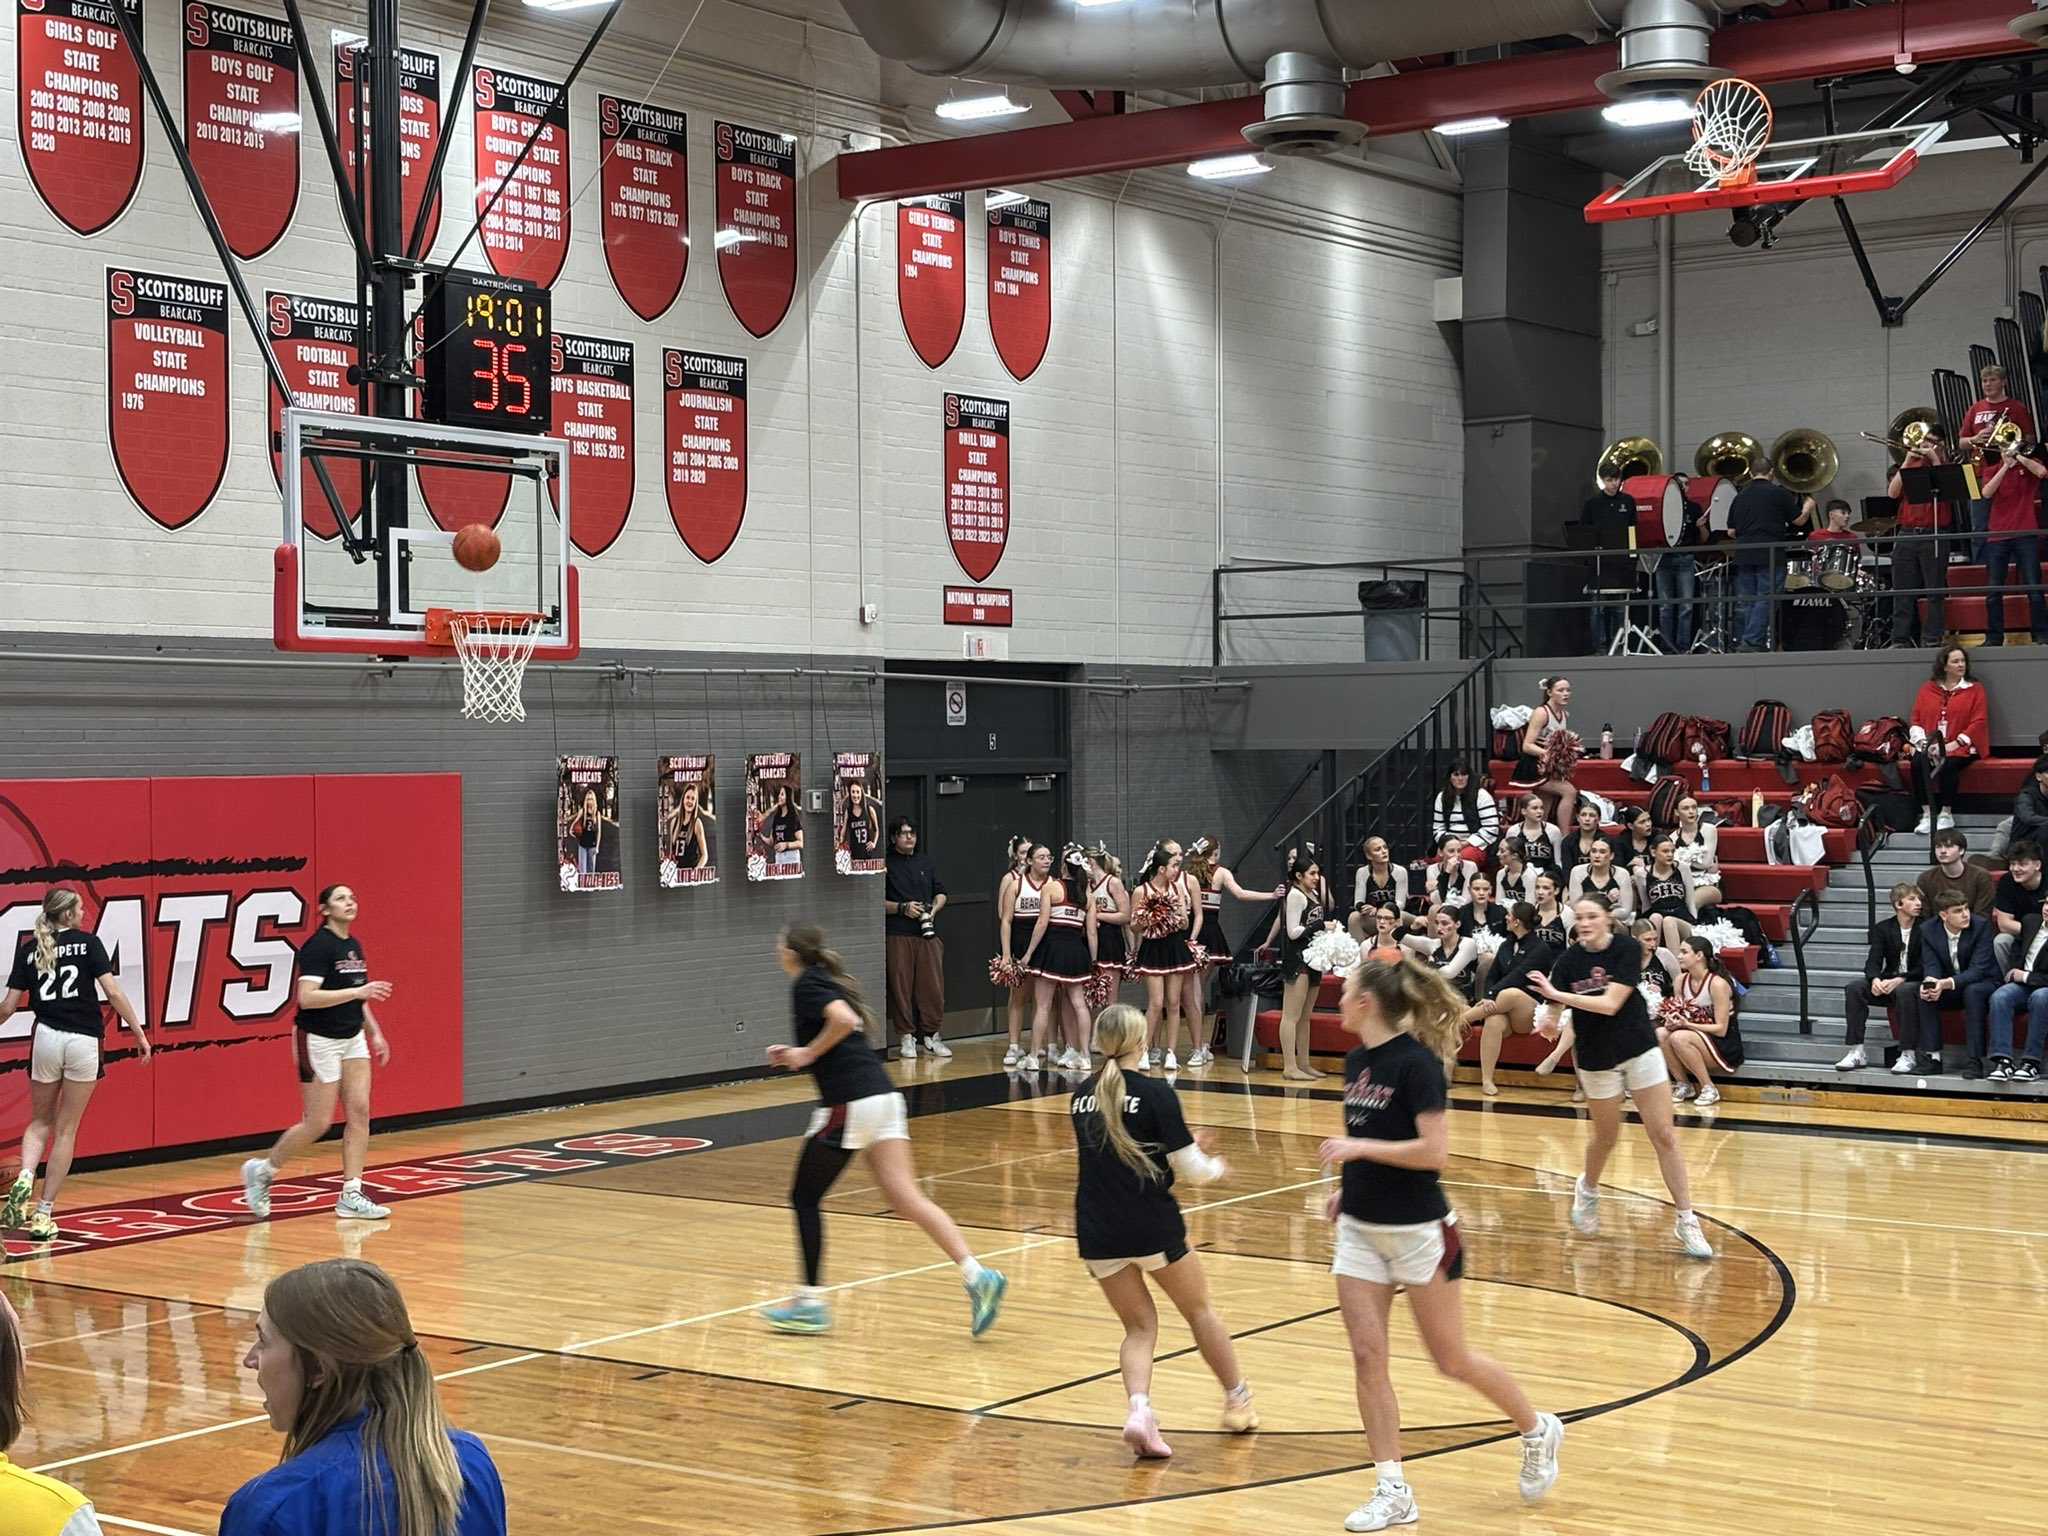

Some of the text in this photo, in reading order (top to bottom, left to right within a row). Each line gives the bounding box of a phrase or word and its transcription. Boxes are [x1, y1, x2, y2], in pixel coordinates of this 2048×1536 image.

[71, 3, 117, 25] BEARCATS
[45, 19, 118, 50] GIRLS GOLF
[186, 3, 209, 47] S
[211, 11, 294, 44] SCOTTSBLUFF
[233, 39, 274, 59] BEARCATS
[64, 49, 100, 72] STATE
[211, 55, 274, 83] BOYS GOLF
[45, 71, 119, 100] CHAMPIONS
[226, 83, 259, 104] STATE
[475, 68, 495, 109] S
[31, 90, 131, 123] 2003 2006 2008 2009
[491, 113, 518, 135] BOYS
[602, 98, 619, 136] S
[621, 104, 683, 132] SCOTTSBLUFF
[31, 112, 131, 145] 2010 2013 2014 2019
[197, 122, 265, 150] 2010 2013 2015
[400, 119, 430, 139] STATE
[637, 128, 668, 145] BEARCATS
[32, 133, 55, 152] 2020
[717, 123, 733, 160] S
[734, 129, 793, 156] SCOTTSBLUFF
[532, 145, 560, 165] STATE
[616, 142, 673, 168] GIRLS TRACK
[749, 153, 778, 169] BEARCATS
[632, 167, 658, 185] STATE
[731, 166, 782, 191] BOYS TRACK
[620, 185, 671, 209] CHAMPIONS
[745, 190, 769, 208] STATE
[610, 201, 627, 218] 1976
[629, 204, 645, 221] 1977
[663, 211, 679, 228] 2007
[733, 207, 781, 230] CHAMPIONS
[908, 210, 955, 233] GIRLS TENNIS
[525, 221, 542, 237] 2010
[485, 231, 523, 252] 2013 2014
[922, 232, 942, 249] STATE
[999, 229, 1040, 250] BOYS TENNIS
[912, 249, 952, 269] CHAMPIONS
[1010, 250, 1029, 266] STATE
[472, 277, 524, 293] DAKTRONICS
[1001, 266, 1039, 285] CHAMPIONS
[111, 271, 134, 315] S
[137, 277, 223, 307] SCOTTSBLUFF
[160, 305, 202, 322] BEARCATS
[270, 295, 291, 337] S
[467, 294, 543, 337] 19:01
[134, 322, 205, 348] VOLLEYBALL
[314, 326, 352, 343] BEARCATS
[153, 350, 187, 370] STATE
[297, 345, 349, 367] FOOTBALL
[565, 339, 630, 362] SCOTTSBLUFF
[582, 362, 615, 377] BEARCATS
[666, 350, 682, 387] S
[684, 355, 744, 377] SCOTTSBLUFF
[135, 373, 205, 397] CHAMPIONS
[308, 369, 339, 388] STATE
[472, 339, 531, 414] 35
[699, 377, 729, 391] BEARCATS
[551, 376, 631, 400] BOYS BASKETBALL
[121, 392, 144, 411] 1976
[292, 391, 356, 414] CHAMPIONS
[577, 401, 604, 418] STATE
[679, 393, 732, 412] JOURNALISM
[946, 395, 959, 427] S
[960, 399, 1007, 418] SCOTTSBLUFF
[564, 421, 617, 441] CHAMPIONS
[694, 415, 719, 431] STATE
[972, 418, 995, 430] BEARCATS
[682, 434, 731, 453] CHAMPIONS
[959, 431, 996, 448] DRILL TEAM
[608, 444, 625, 459] 2012
[673, 451, 688, 466] 2001
[690, 452, 706, 467] 2004
[707, 454, 722, 469] 2005
[968, 451, 987, 465] STATE
[673, 468, 706, 484] 2019 2020
[959, 468, 997, 485] CHAMPIONS
[947, 591, 1009, 607] NATIONAL CHAMPIONS
[669, 756, 706, 769] SCOTTSBLUFF
[754, 754, 791, 766] SCOTTSBLUFF
[572, 772, 602, 783] BEARCATS
[674, 771, 702, 782] BEARCATS
[759, 768, 786, 779] BEARCATS
[855, 829, 867, 844] 43
[675, 840, 685, 857] 13
[1649, 883, 1684, 903] SHS
[38, 964, 79, 1001] 22
